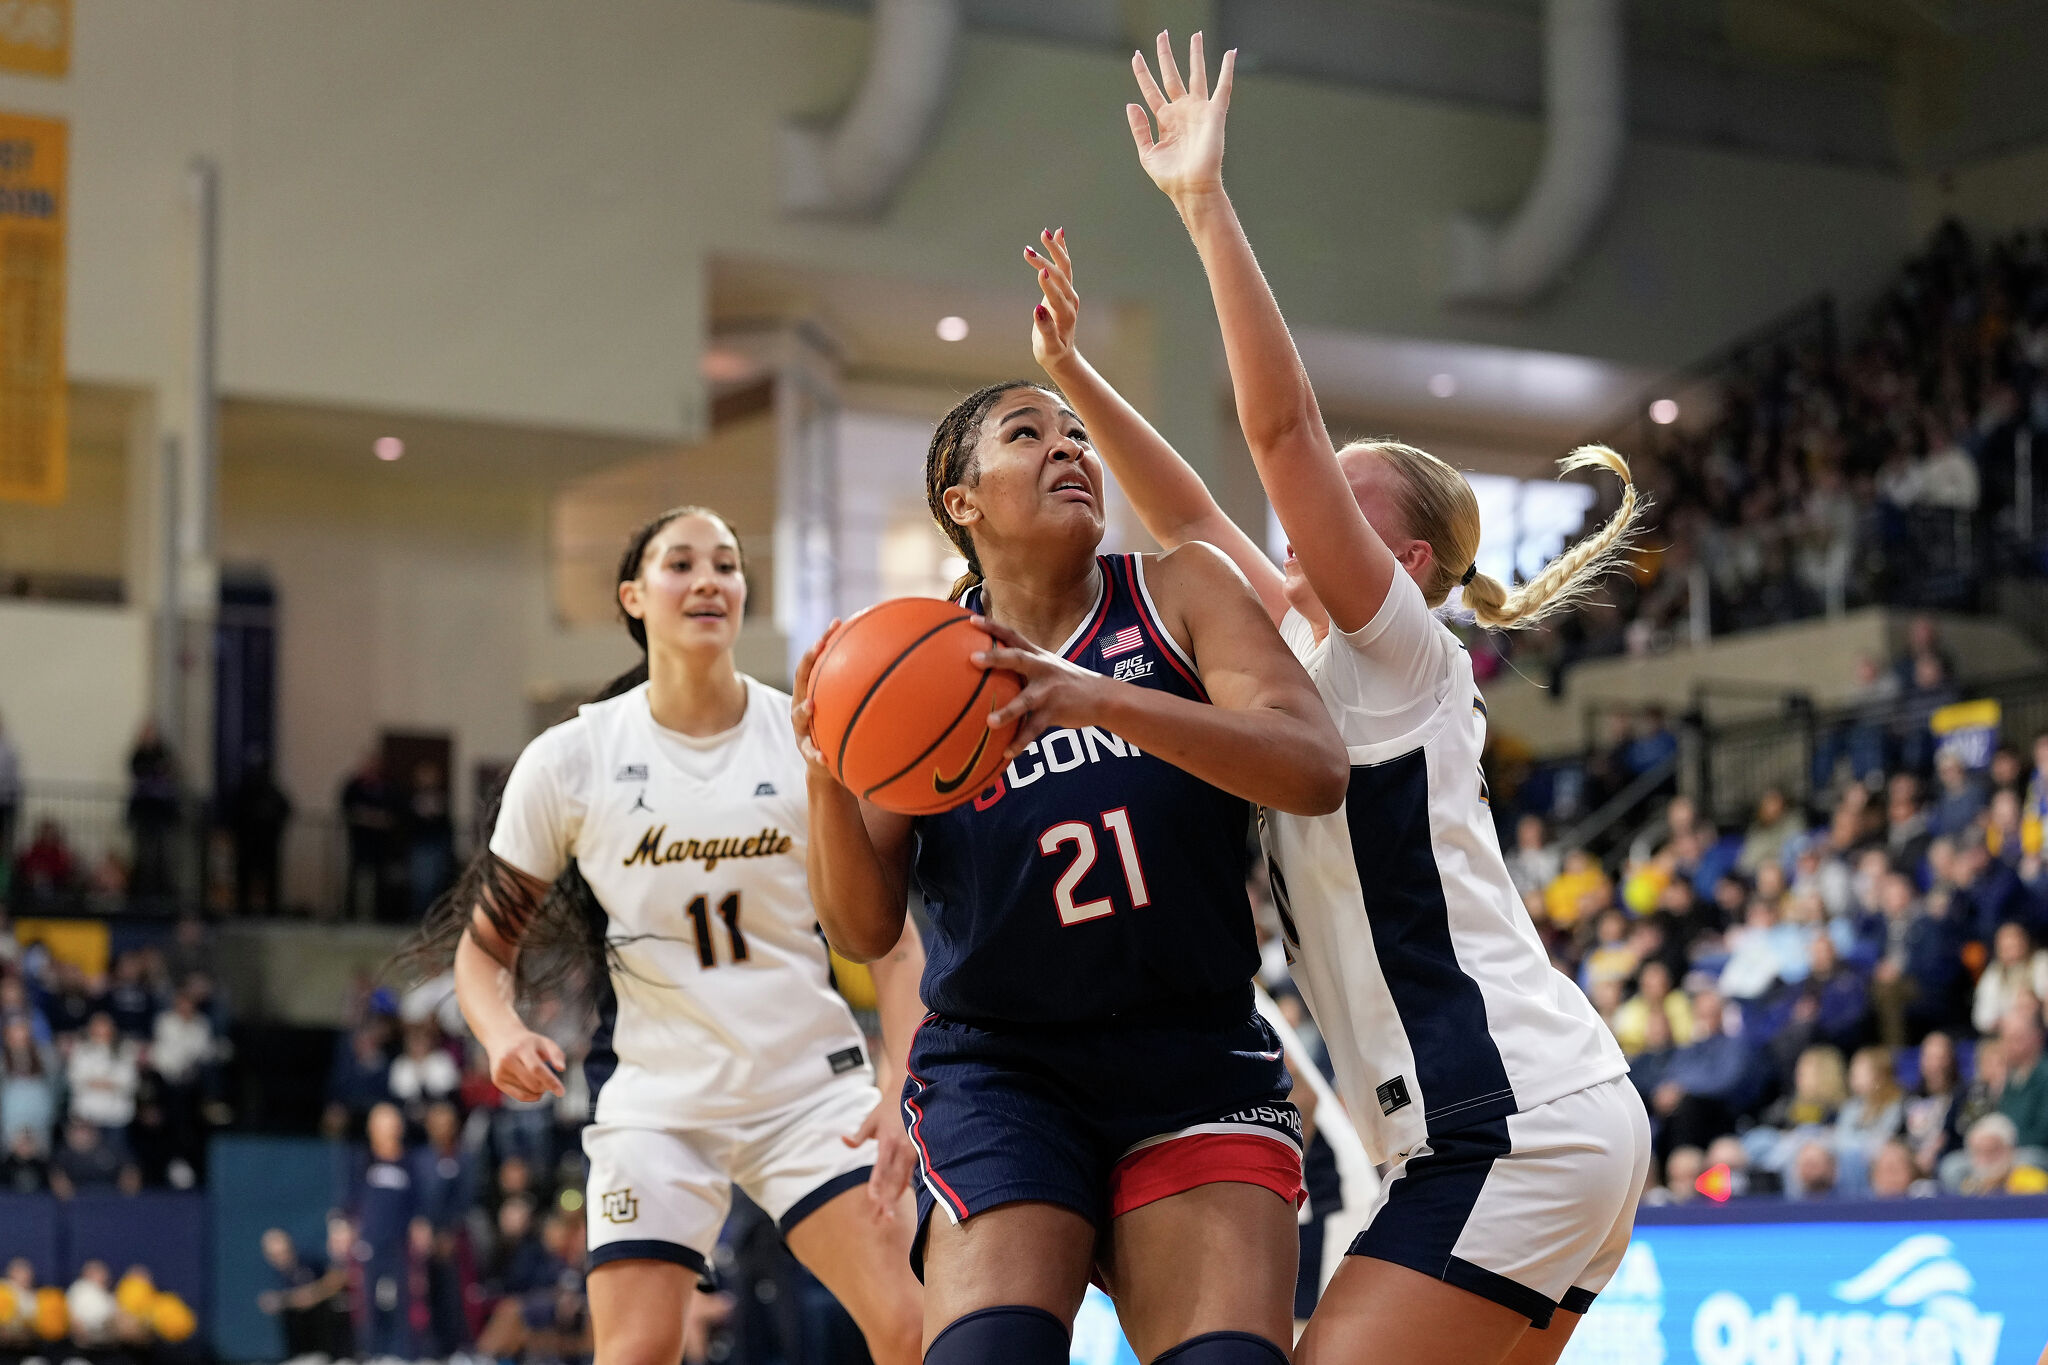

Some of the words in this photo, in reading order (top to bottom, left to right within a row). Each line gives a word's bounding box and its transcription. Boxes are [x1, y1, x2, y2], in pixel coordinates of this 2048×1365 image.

[1113, 660, 1155, 681] EAST
[1114, 654, 1144, 673] BIG
[623, 824, 795, 872] Marquette
[1037, 806, 1151, 927] 21
[684, 890, 751, 971] 11
[1692, 1291, 2003, 1365] Odyssey
